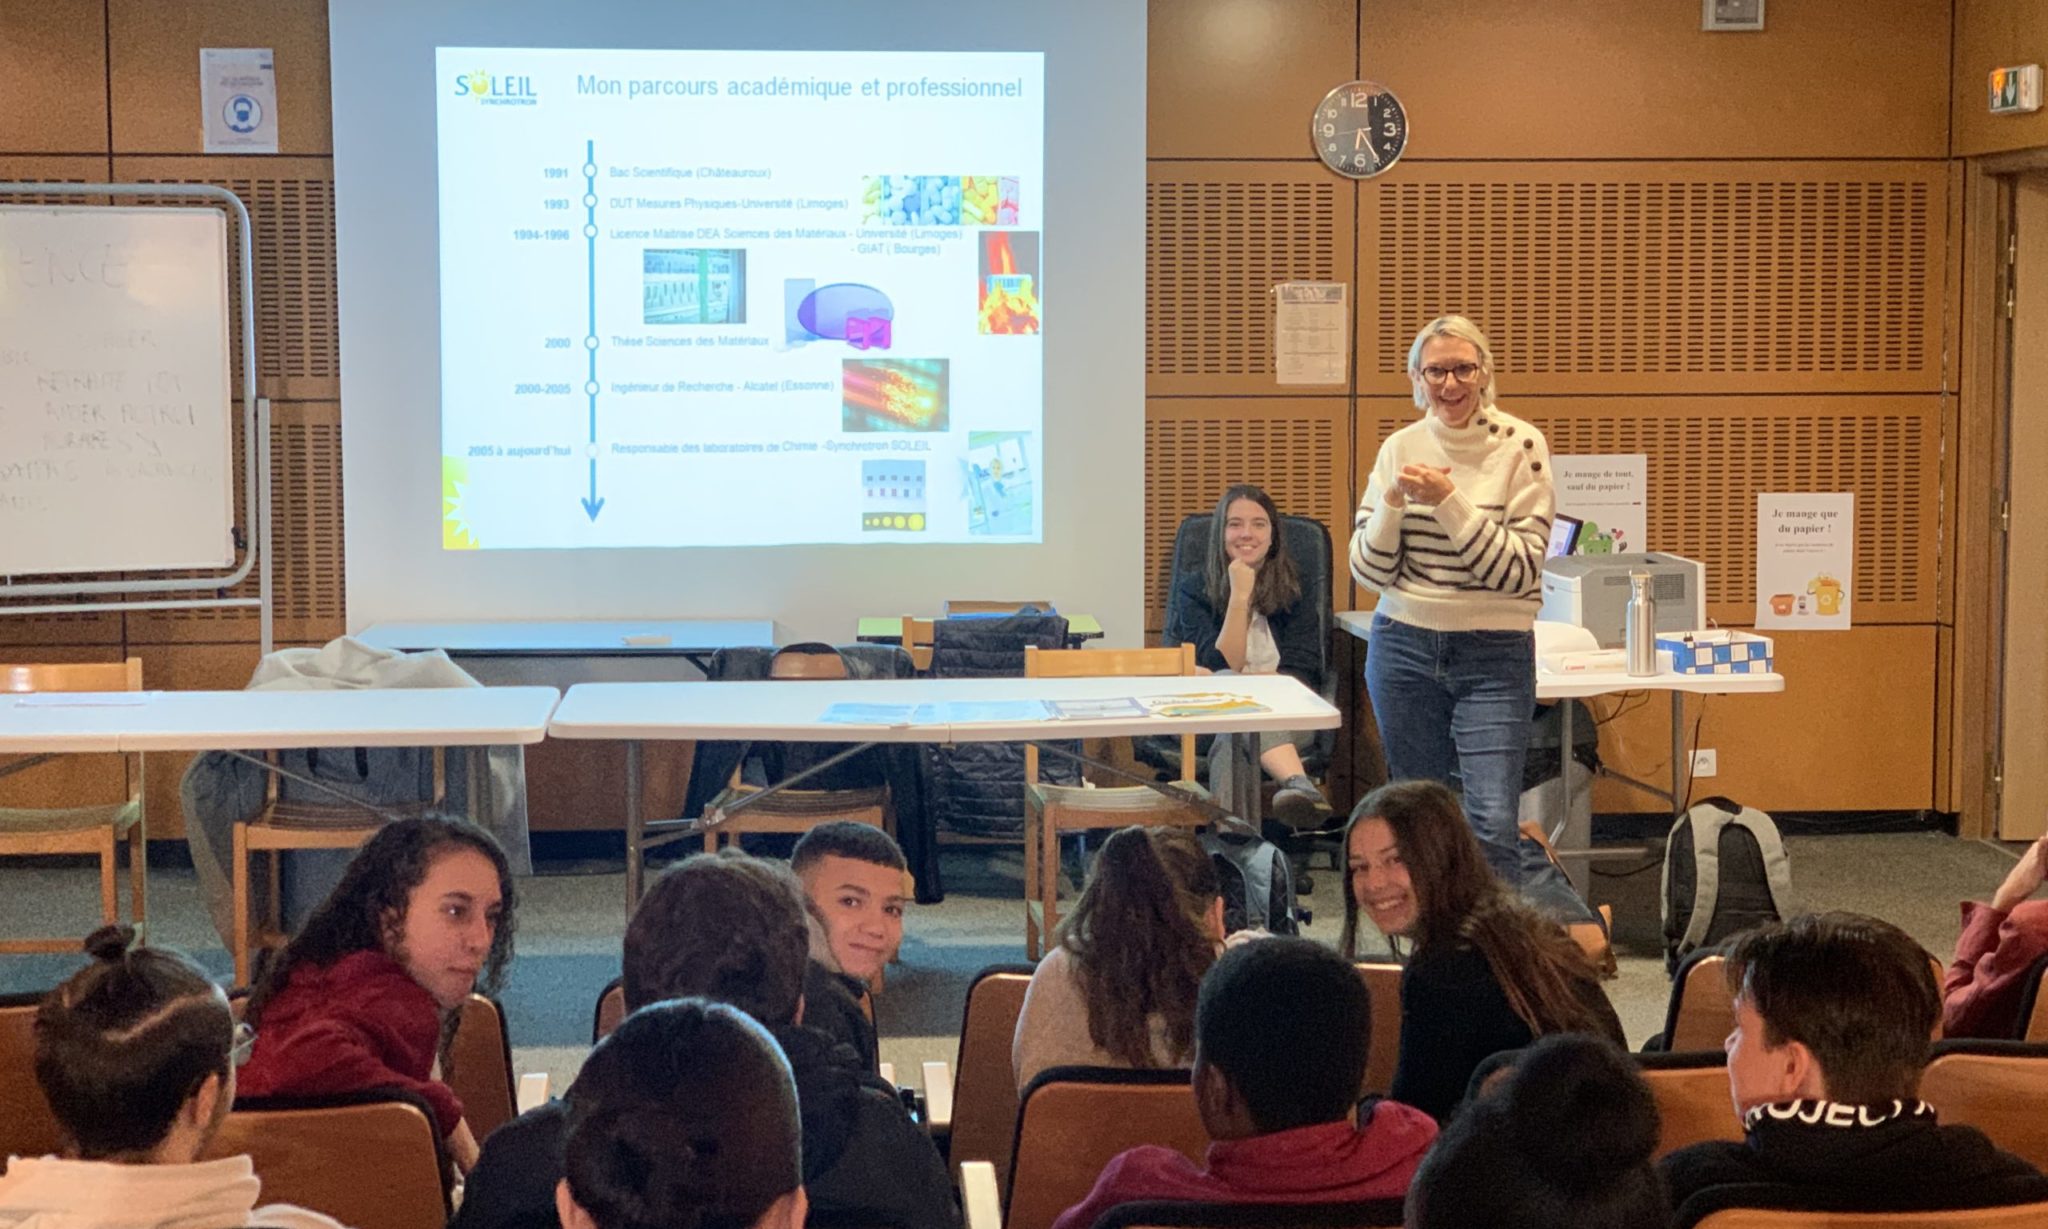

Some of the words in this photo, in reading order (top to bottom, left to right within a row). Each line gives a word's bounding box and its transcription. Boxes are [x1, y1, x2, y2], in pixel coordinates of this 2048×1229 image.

[577, 75, 622, 95] Mon
[628, 77, 719, 100] parcours
[728, 75, 852, 101] académique
[861, 77, 880, 97] et
[887, 77, 1023, 101] professionnel
[1350, 92, 1368, 108] 12
[1383, 108, 1392, 118] 2
[1323, 123, 1335, 138] 9
[1383, 122, 1396, 137] 3
[1383, 142, 1391, 151] 4
[1354, 153, 1366, 168] 6
[543, 168, 569, 179] 1991
[609, 167, 630, 178] Bac
[632, 166, 693, 180] Scientifique
[696, 167, 772, 180] (Châteauroux)
[543, 198, 570, 210] 1993
[636, 197, 681, 209] Mesures
[796, 198, 849, 211] (Limoges)
[513, 229, 570, 240] 1994-1996
[610, 228, 650, 239] Licence
[696, 228, 720, 239] DEA
[723, 228, 770, 239] Sciences
[773, 228, 792, 239] des
[795, 227, 847, 239] Matériaux
[856, 227, 907, 239] Université
[911, 228, 963, 241] (Limoges)
[857, 243, 884, 254] GIAT
[544, 337, 571, 349] 2000
[646, 336, 692, 346] Sciences
[695, 336, 714, 346] des
[718, 335, 769, 346] Matériaux
[514, 383, 571, 395] 2000-2005
[611, 382, 659, 394] Ingénieur
[662, 381, 675, 392] de
[678, 380, 734, 392] Recherche
[743, 380, 778, 391] Alcatel
[781, 380, 834, 392] (Essonne)
[468, 445, 495, 456] 2005
[497, 445, 504, 456] à
[506, 445, 572, 459] aujourd'hui
[611, 443, 679, 455] Responsable
[681, 442, 700, 453] des
[703, 442, 763, 453] laboratoires
[766, 441, 780, 452] de
[782, 441, 818, 452] Chimie
[891, 440, 932, 452] SOLEIL
[1575, 471, 1601, 480] mange
[1603, 470, 1612, 478] de
[1567, 482, 1584, 490] sauf
[1585, 482, 1596, 490] du
[1598, 483, 1625, 492] papier
[1772, 508, 1783, 518] Je
[1786, 511, 1818, 520] mange
[1820, 511, 1839, 520] que
[1778, 524, 1791, 533] du
[1793, 524, 1825, 535] papier
